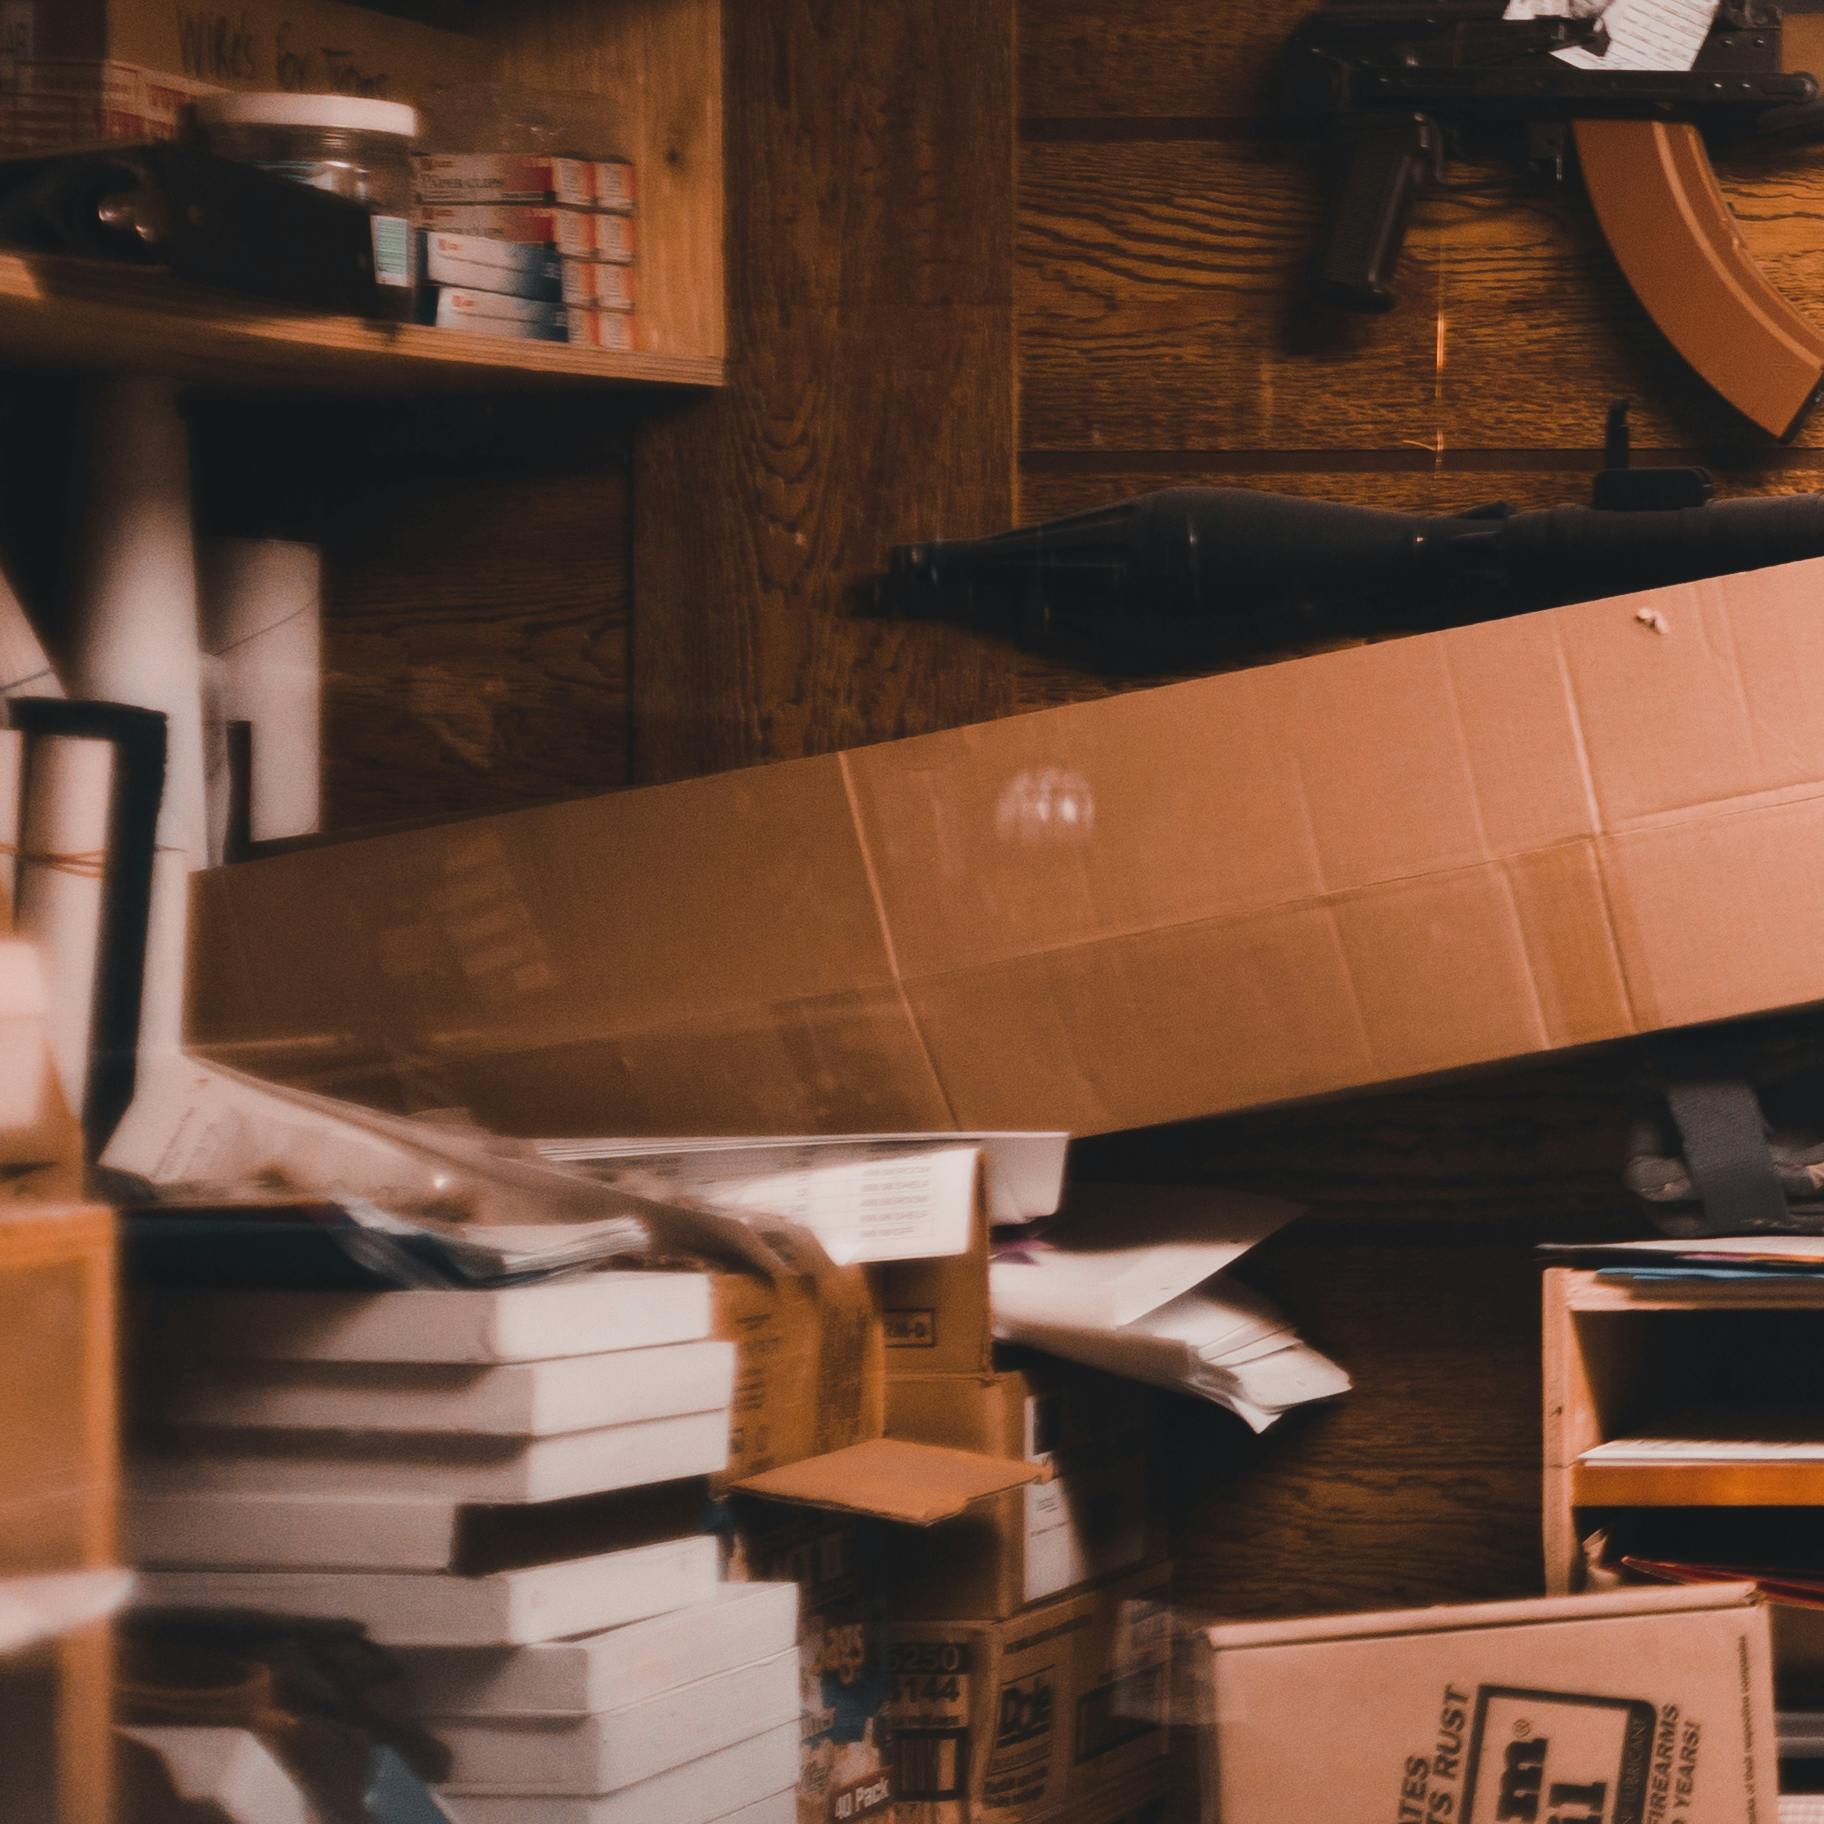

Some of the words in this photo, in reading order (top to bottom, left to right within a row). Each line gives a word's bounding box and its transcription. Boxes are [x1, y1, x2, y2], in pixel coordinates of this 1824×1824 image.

[1432, 1684, 1469, 1781] RUST
[1673, 1720, 1702, 1809] YEARS!
[855, 1775, 890, 1813] Pack
